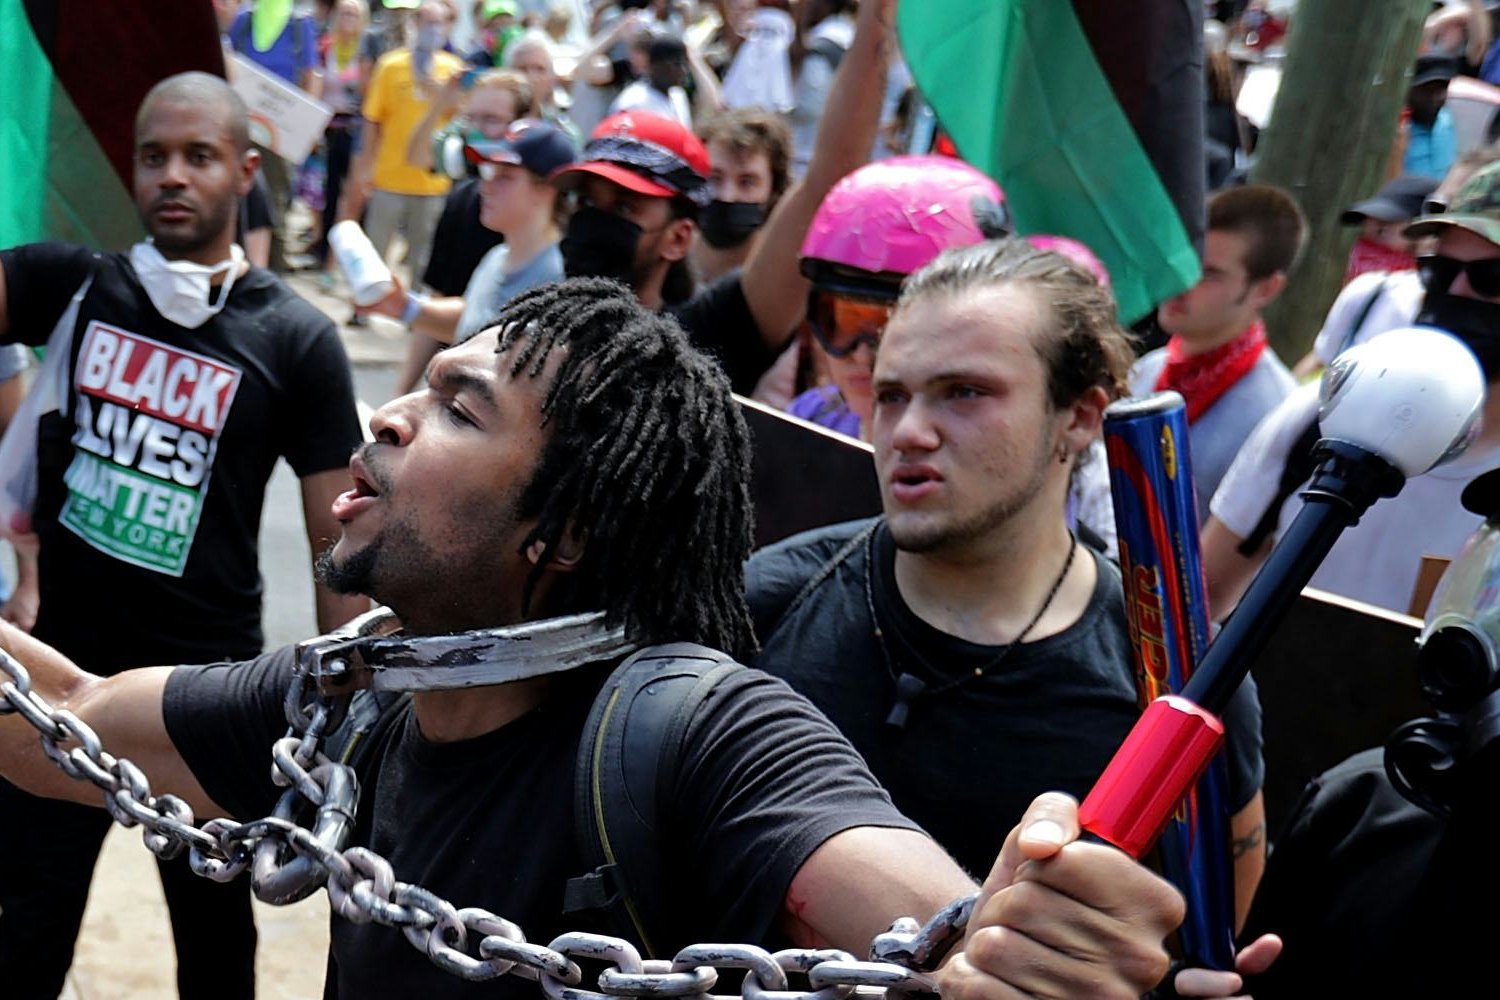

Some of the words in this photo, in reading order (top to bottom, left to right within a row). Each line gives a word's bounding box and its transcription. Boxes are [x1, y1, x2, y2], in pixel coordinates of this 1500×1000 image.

[82, 330, 233, 429] BLACK
[71, 394, 209, 487] LIVES
[63, 452, 196, 534] MATTER
[112, 516, 186, 557] YORK
